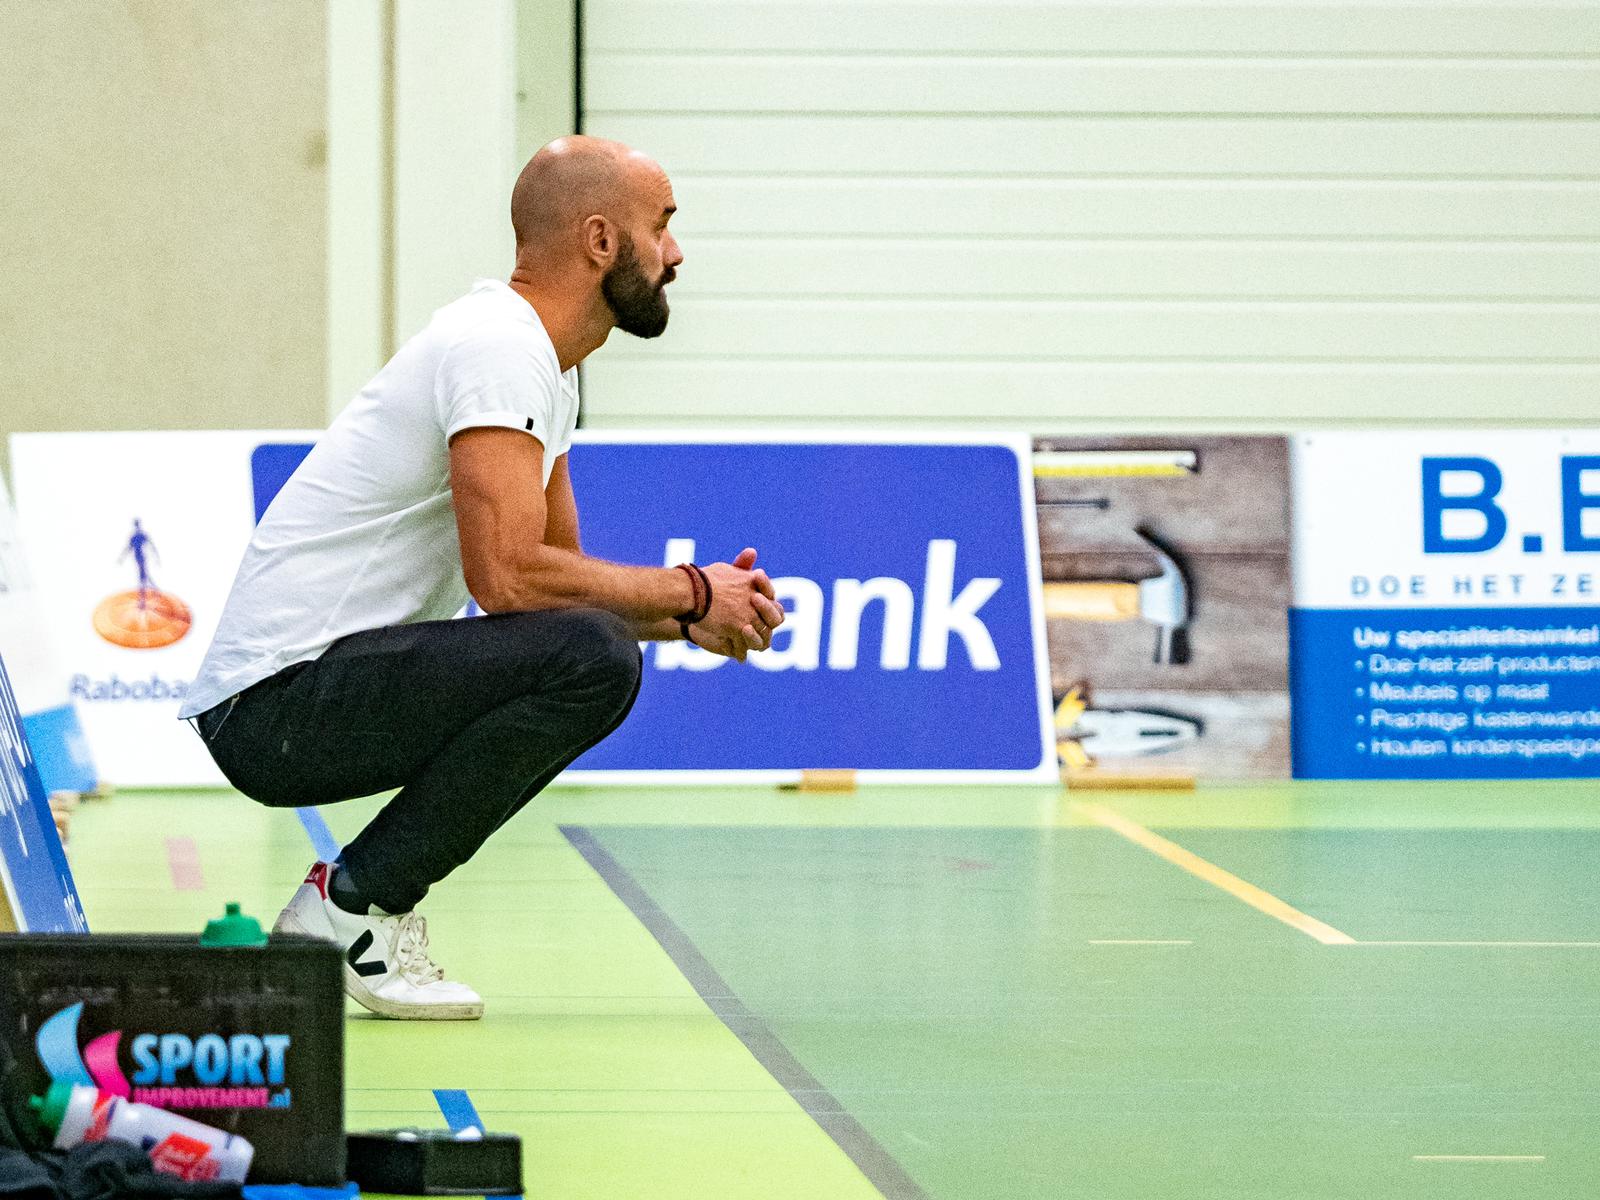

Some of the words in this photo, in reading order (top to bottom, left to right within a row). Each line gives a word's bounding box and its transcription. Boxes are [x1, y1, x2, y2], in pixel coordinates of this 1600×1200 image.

[1350, 574, 1425, 596] DOE
[1452, 574, 1525, 595] HET
[1550, 573, 1593, 594] ZE
[1353, 627, 1391, 648] Uw
[1396, 625, 1600, 650] specialiteitswinkel
[1369, 681, 1459, 702] Meubels
[1463, 684, 1492, 704] op
[1496, 682, 1549, 701] maat
[1370, 707, 1468, 731] Prachtige
[1472, 708, 1600, 728] kastenwand
[1371, 737, 1448, 756] Houten
[131, 1032, 291, 1086] SPORT
